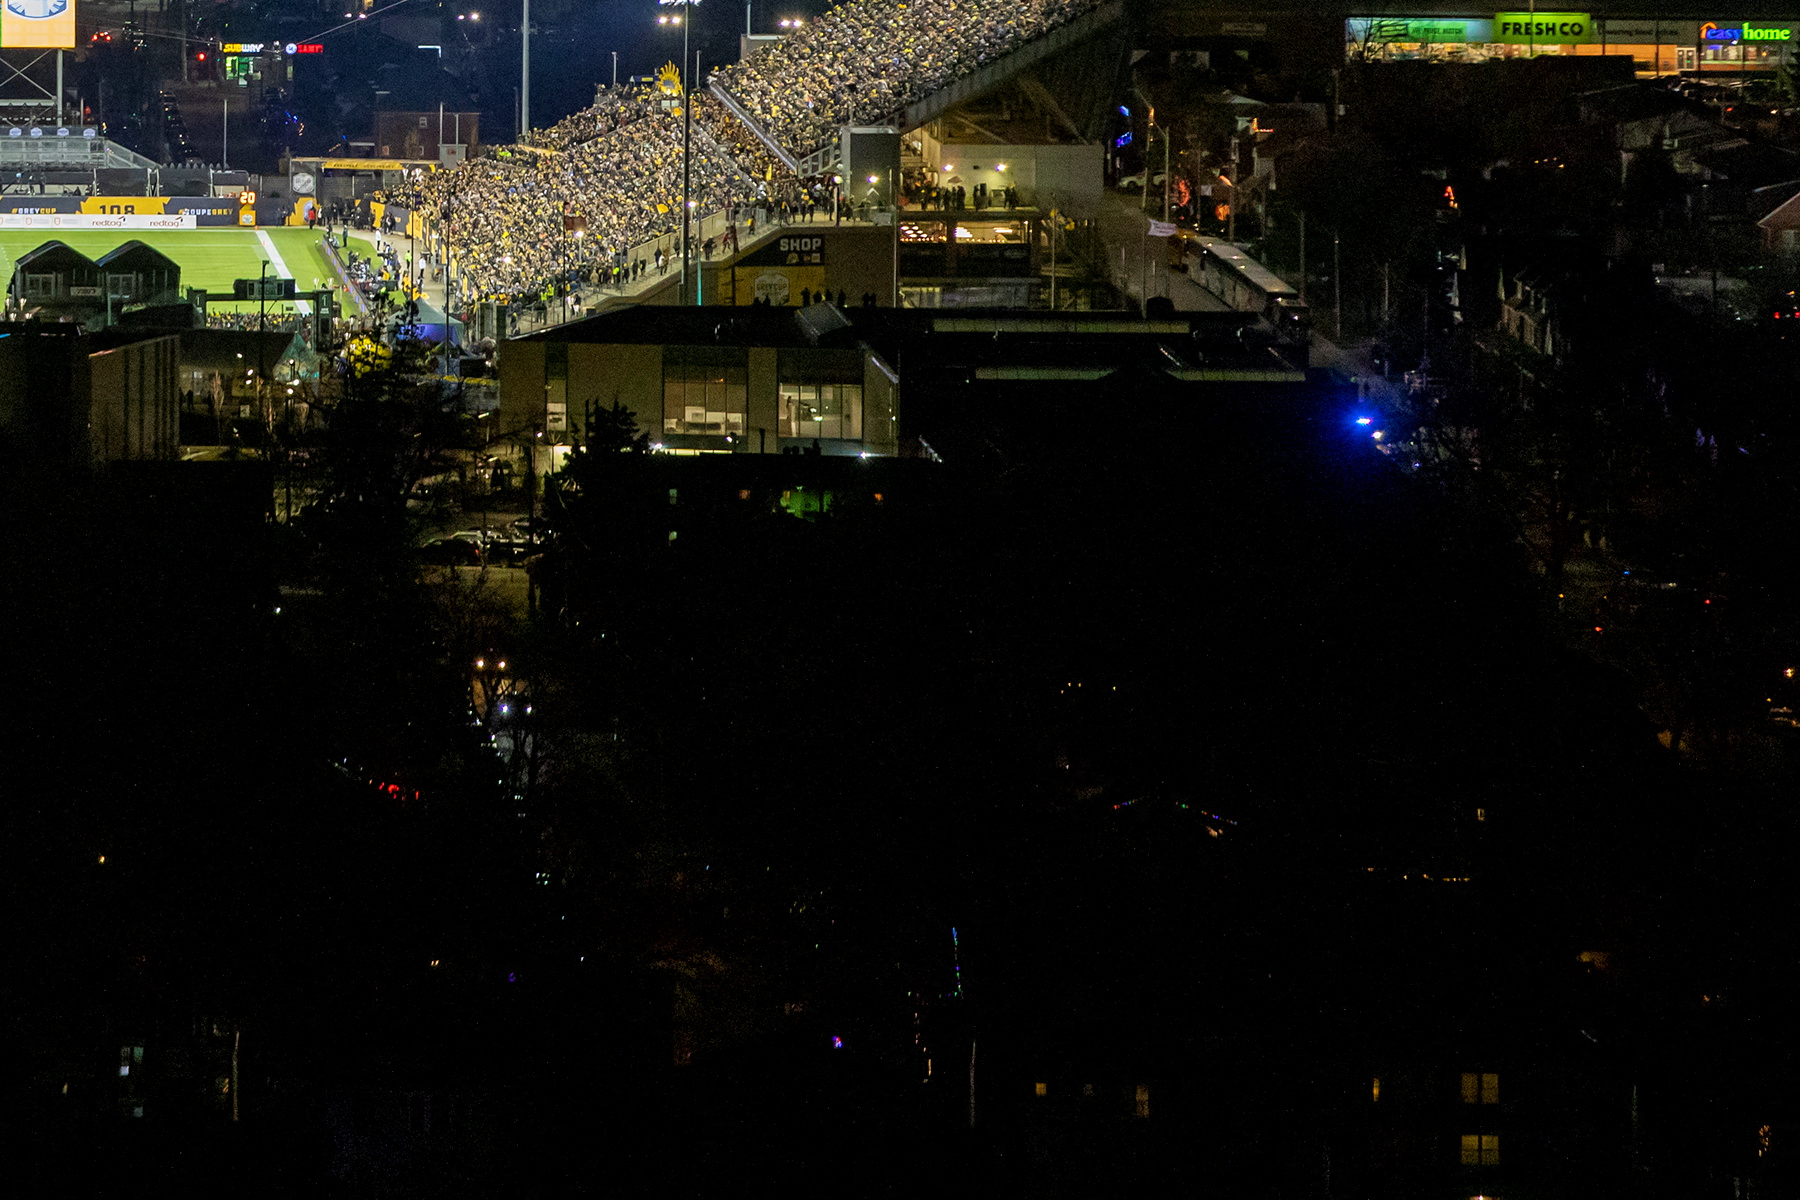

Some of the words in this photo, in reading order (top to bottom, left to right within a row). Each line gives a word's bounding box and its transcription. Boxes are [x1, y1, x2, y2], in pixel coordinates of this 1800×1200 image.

[1502, 22, 1556, 36] FRESH
[223, 43, 264, 53] SUBWAY
[240, 191, 255, 204] 20
[92, 218, 122, 228] redtag
[150, 218, 180, 228] redtag
[779, 238, 822, 251] SHOP
